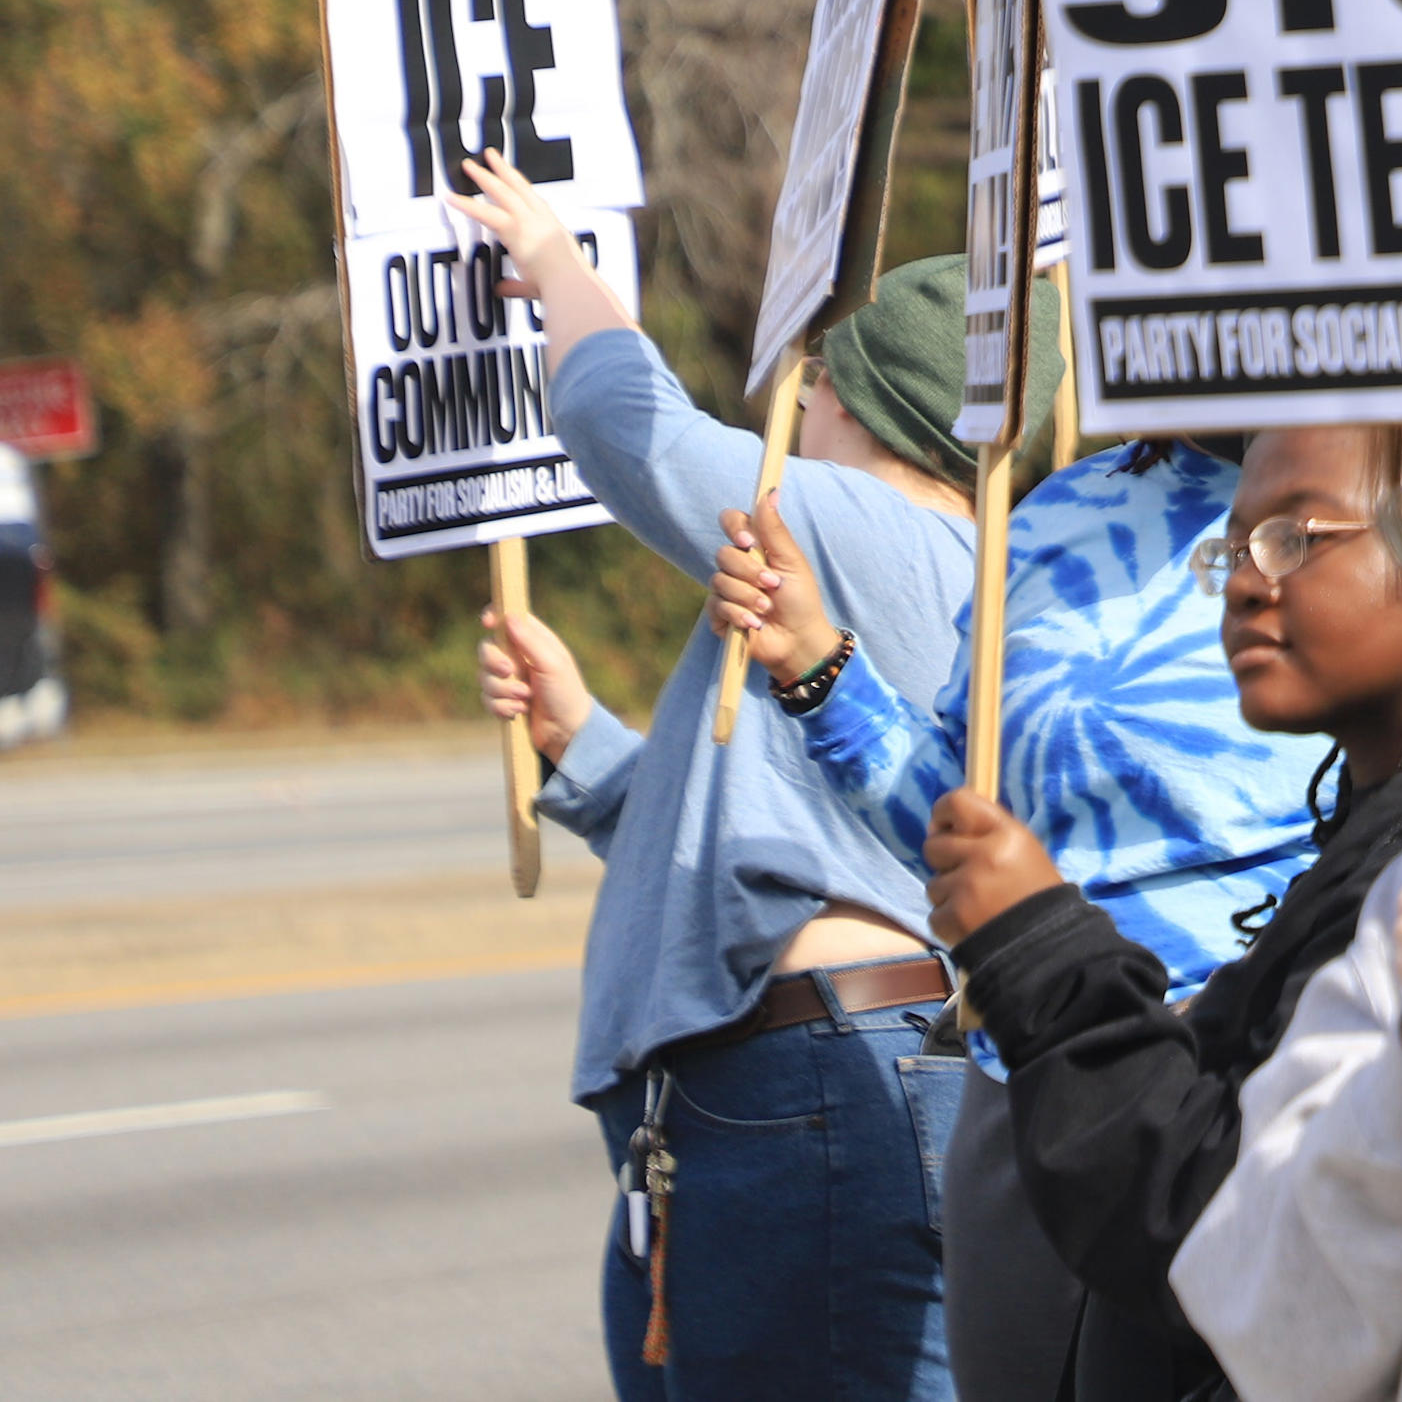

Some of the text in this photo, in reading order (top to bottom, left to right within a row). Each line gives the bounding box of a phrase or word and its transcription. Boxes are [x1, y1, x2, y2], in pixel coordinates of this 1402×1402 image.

[1078, 70, 1266, 271] ICE
[384, 248, 459, 352] OUT
[1100, 310, 1218, 384] PARTY
[1216, 306, 1293, 379] FOR
[370, 343, 554, 464] COMMUN
[377, 486, 426, 530] PARTY
[426, 480, 457, 522] FOR
[456, 467, 539, 516] SOCIALISM
[535, 466, 558, 505] &
